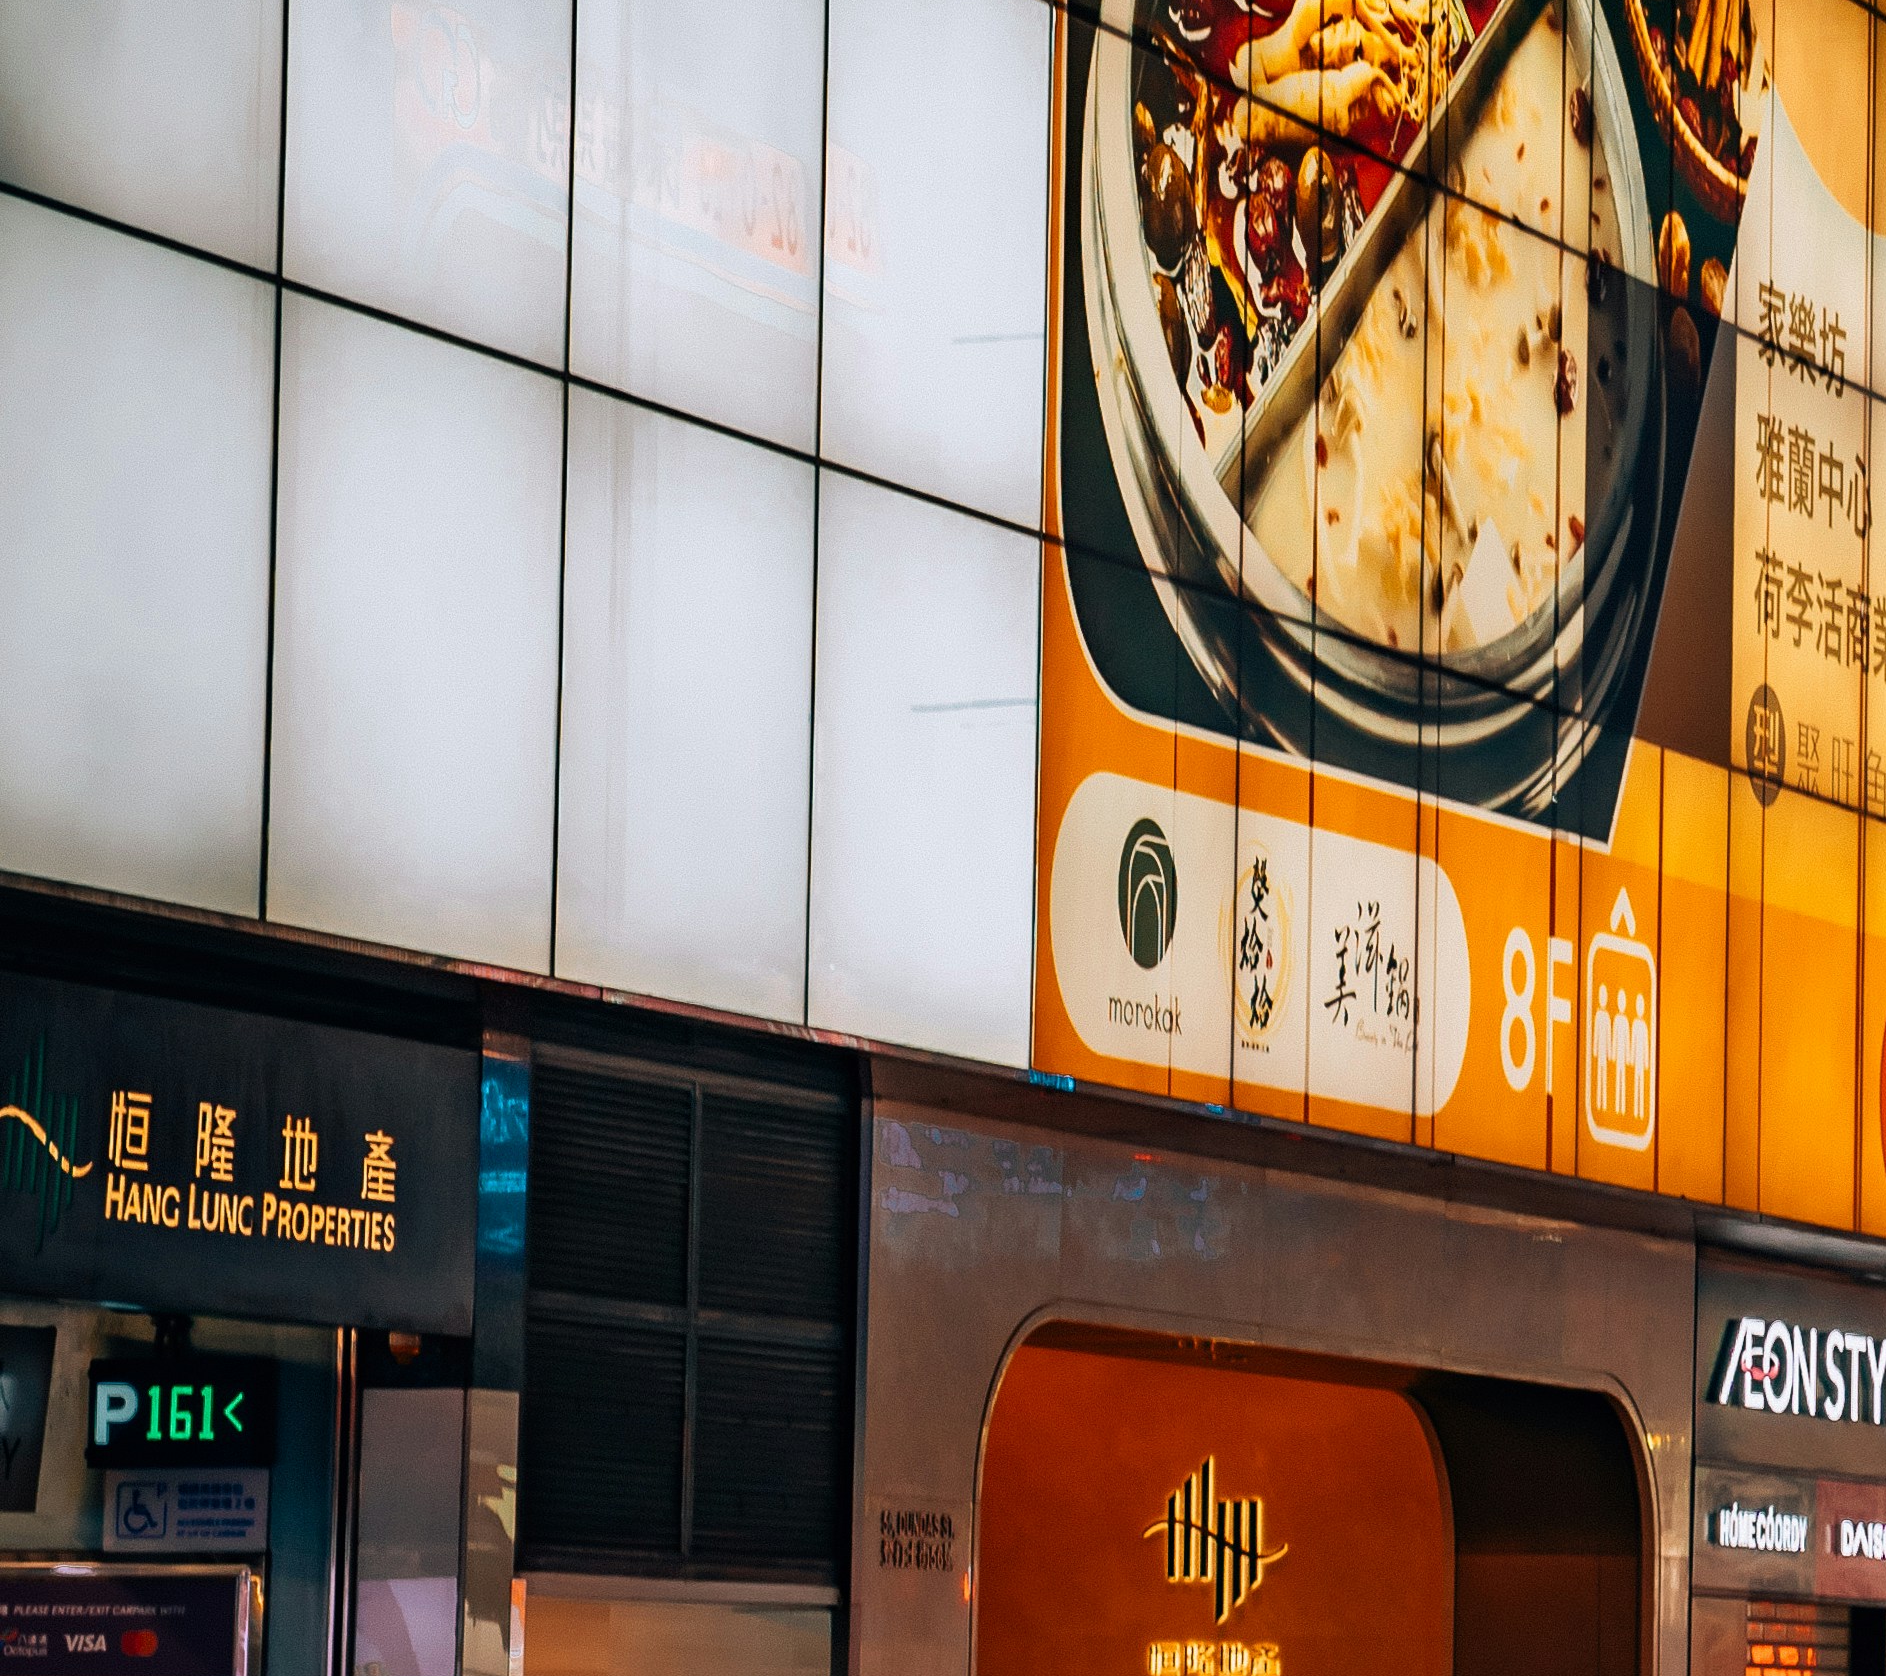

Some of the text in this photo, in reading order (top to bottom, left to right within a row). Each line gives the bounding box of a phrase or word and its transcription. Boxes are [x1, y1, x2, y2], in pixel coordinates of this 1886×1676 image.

[1756, 280, 1848, 400] 家樂坊
[1754, 410, 1874, 540] 雅蘭中心
[1499, 927, 1574, 1094] 8F
[107, 1090, 398, 1204] 恒隆地產
[146, 1384, 215, 1442] 161
[64, 1633, 107, 1652] VISA
